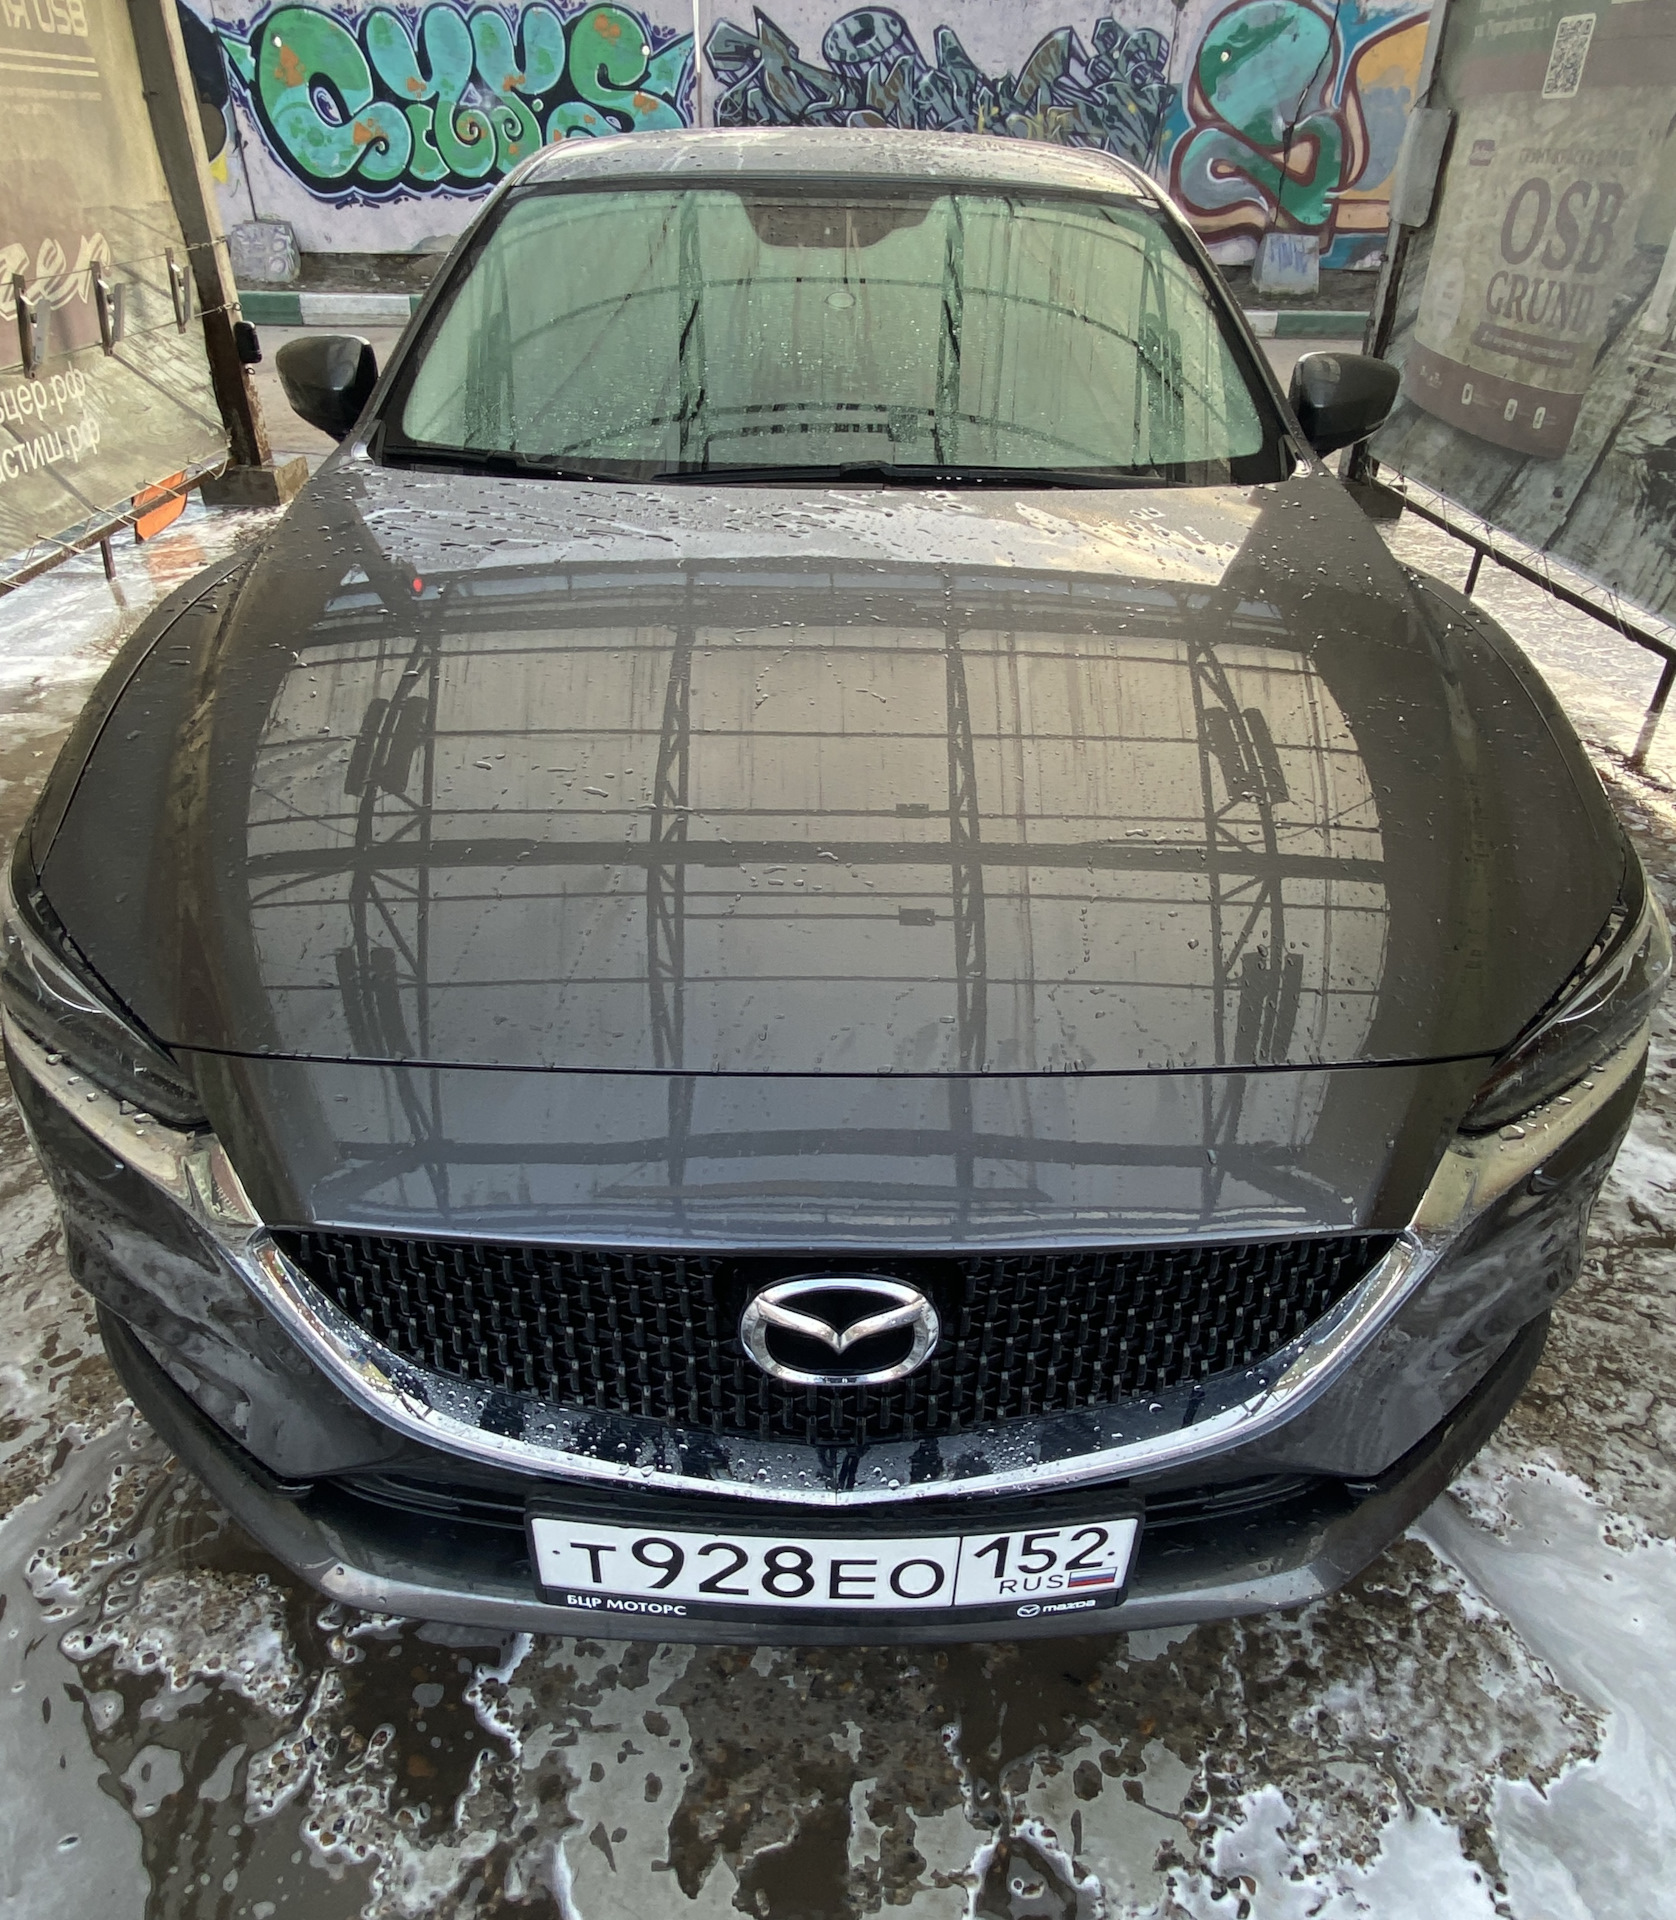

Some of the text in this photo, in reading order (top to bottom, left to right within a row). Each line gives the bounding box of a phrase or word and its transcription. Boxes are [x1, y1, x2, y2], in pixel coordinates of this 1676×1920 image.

[1500, 177, 1626, 274] OSB
[973, 1526, 1110, 1579] 152
[999, 1574, 1064, 1595] RUS
[566, 1594, 687, 1616] БЦР МОТОРС
[1042, 1599, 1096, 1613] mazda
